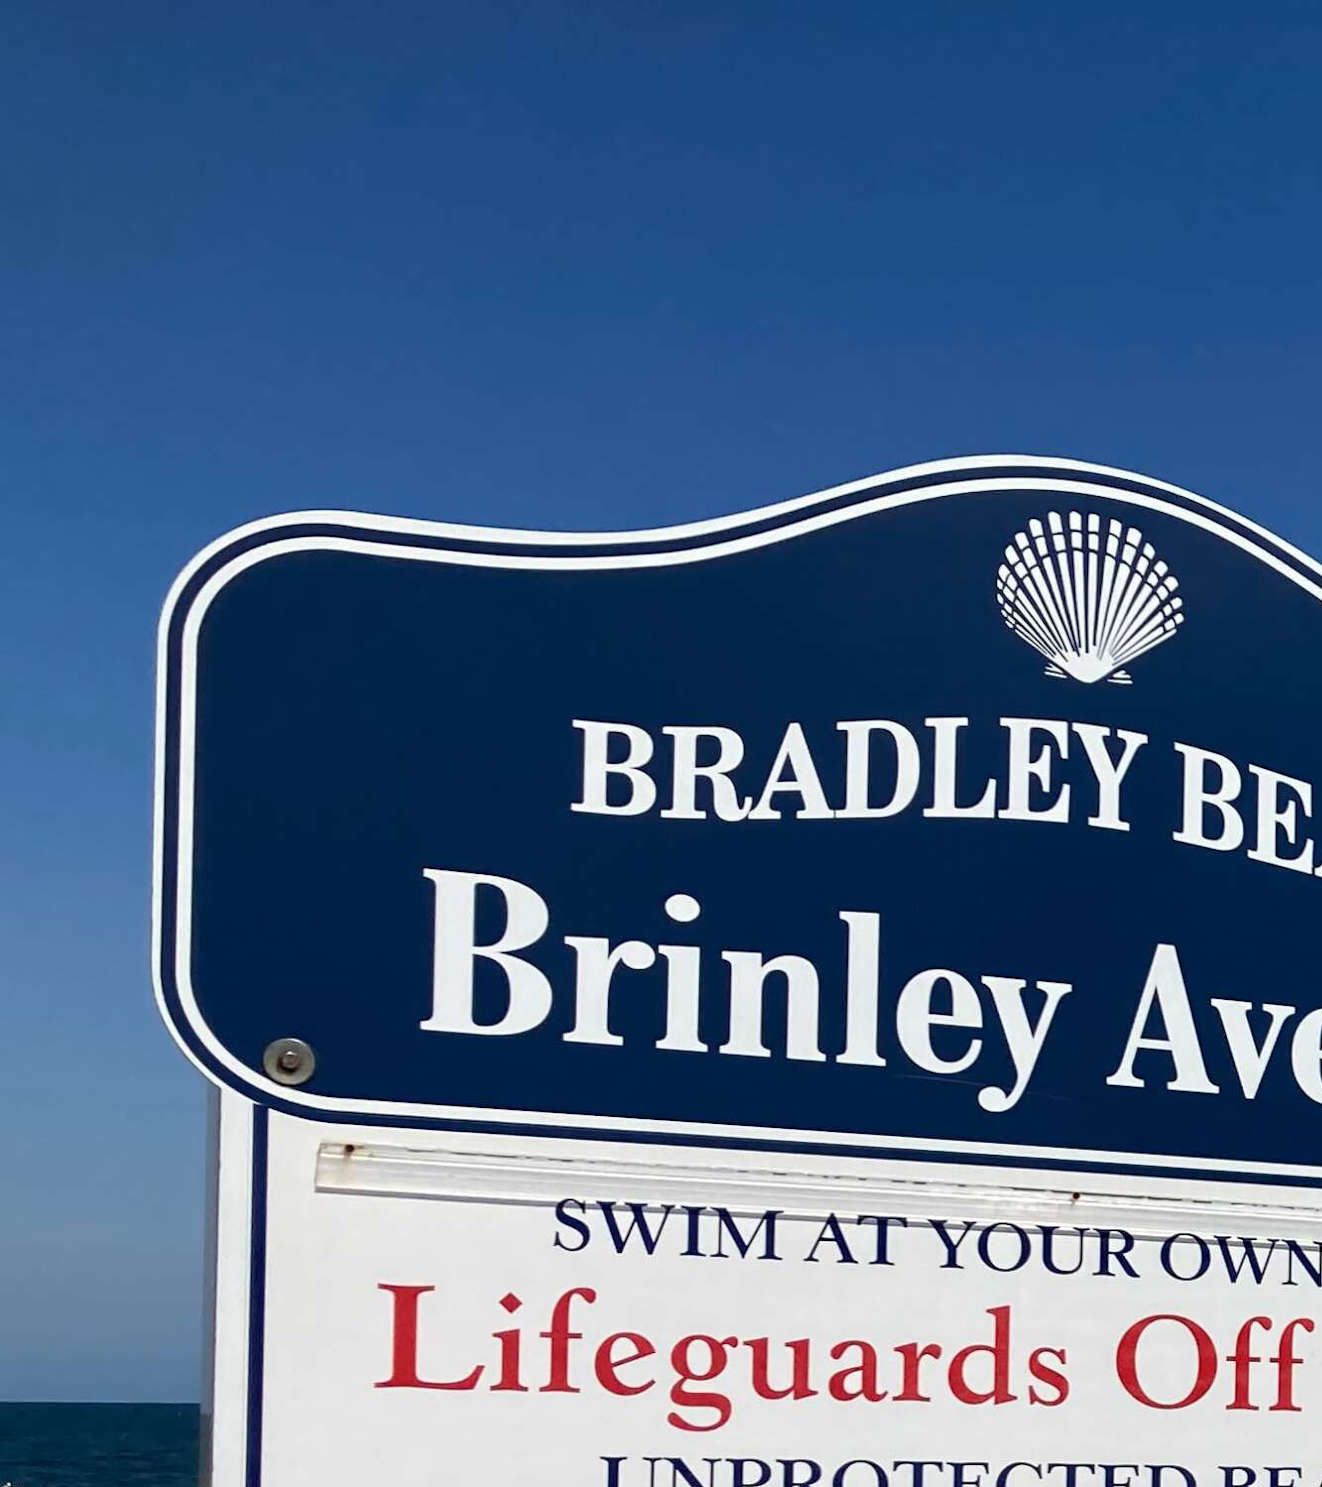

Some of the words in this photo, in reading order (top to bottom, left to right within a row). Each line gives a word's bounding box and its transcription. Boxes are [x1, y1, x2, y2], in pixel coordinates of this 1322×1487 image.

[570, 716, 1149, 832] BRADLEY
[419, 867, 1073, 1113] Brinley
[553, 1198, 784, 1261] SWIM
[804, 1212, 908, 1266] AT
[928, 1218, 1140, 1279] YOUR
[373, 1282, 1070, 1433] Lifeguards
[1115, 1314, 1315, 1413] Off
